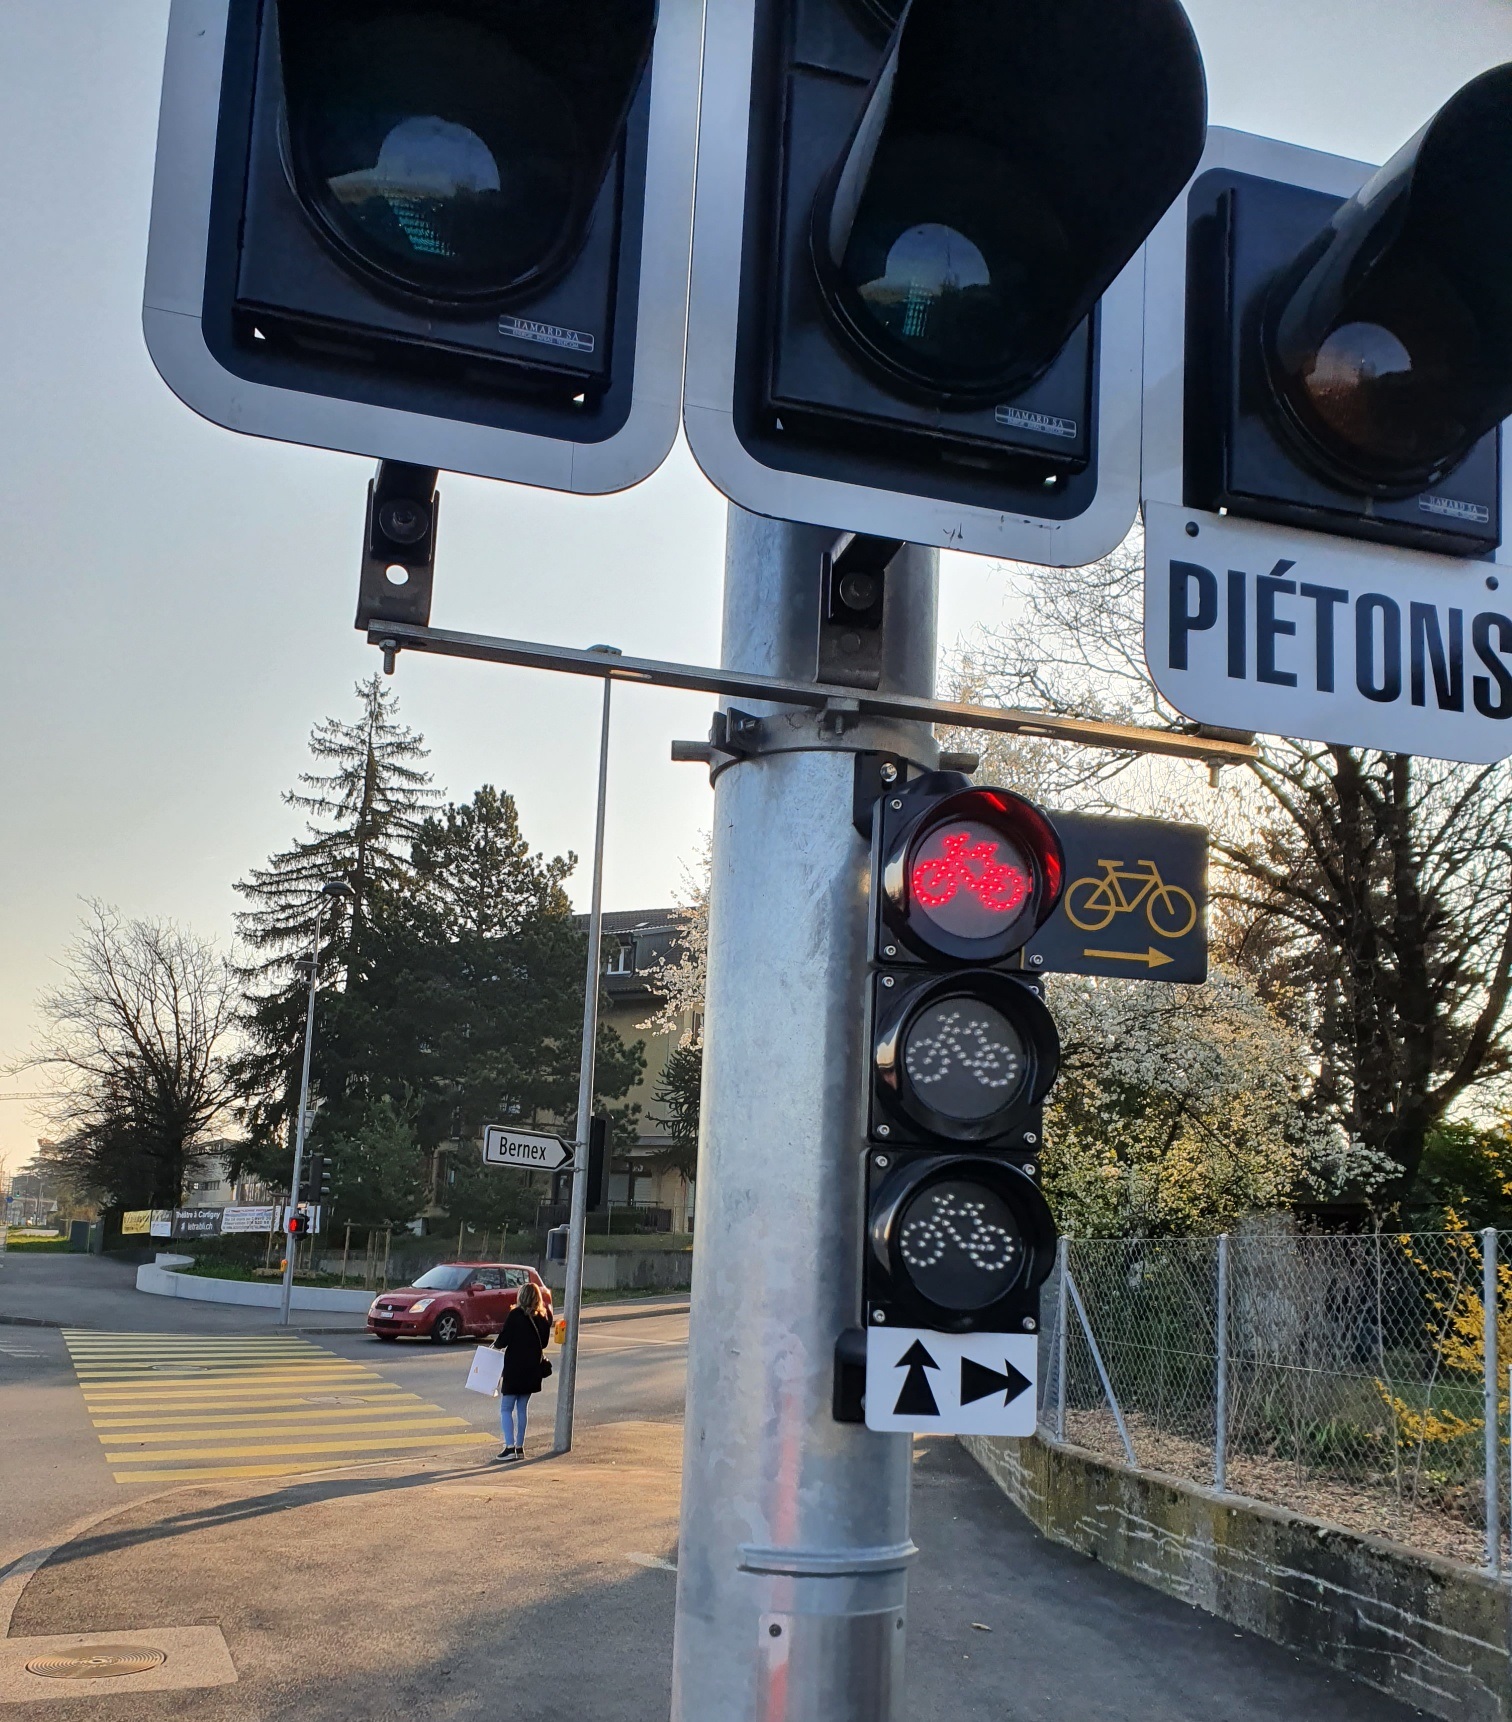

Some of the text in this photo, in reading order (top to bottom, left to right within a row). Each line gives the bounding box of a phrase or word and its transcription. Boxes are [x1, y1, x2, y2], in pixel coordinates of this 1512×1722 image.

[514, 319, 579, 341] HAMARD SA
[1008, 408, 1049, 424] HAMARD
[1052, 418, 1064, 428] SA
[1168, 559, 1512, 720] PIÉTONS
[499, 1136, 547, 1161] Bernex
[198, 1210, 221, 1219] Cartigny
